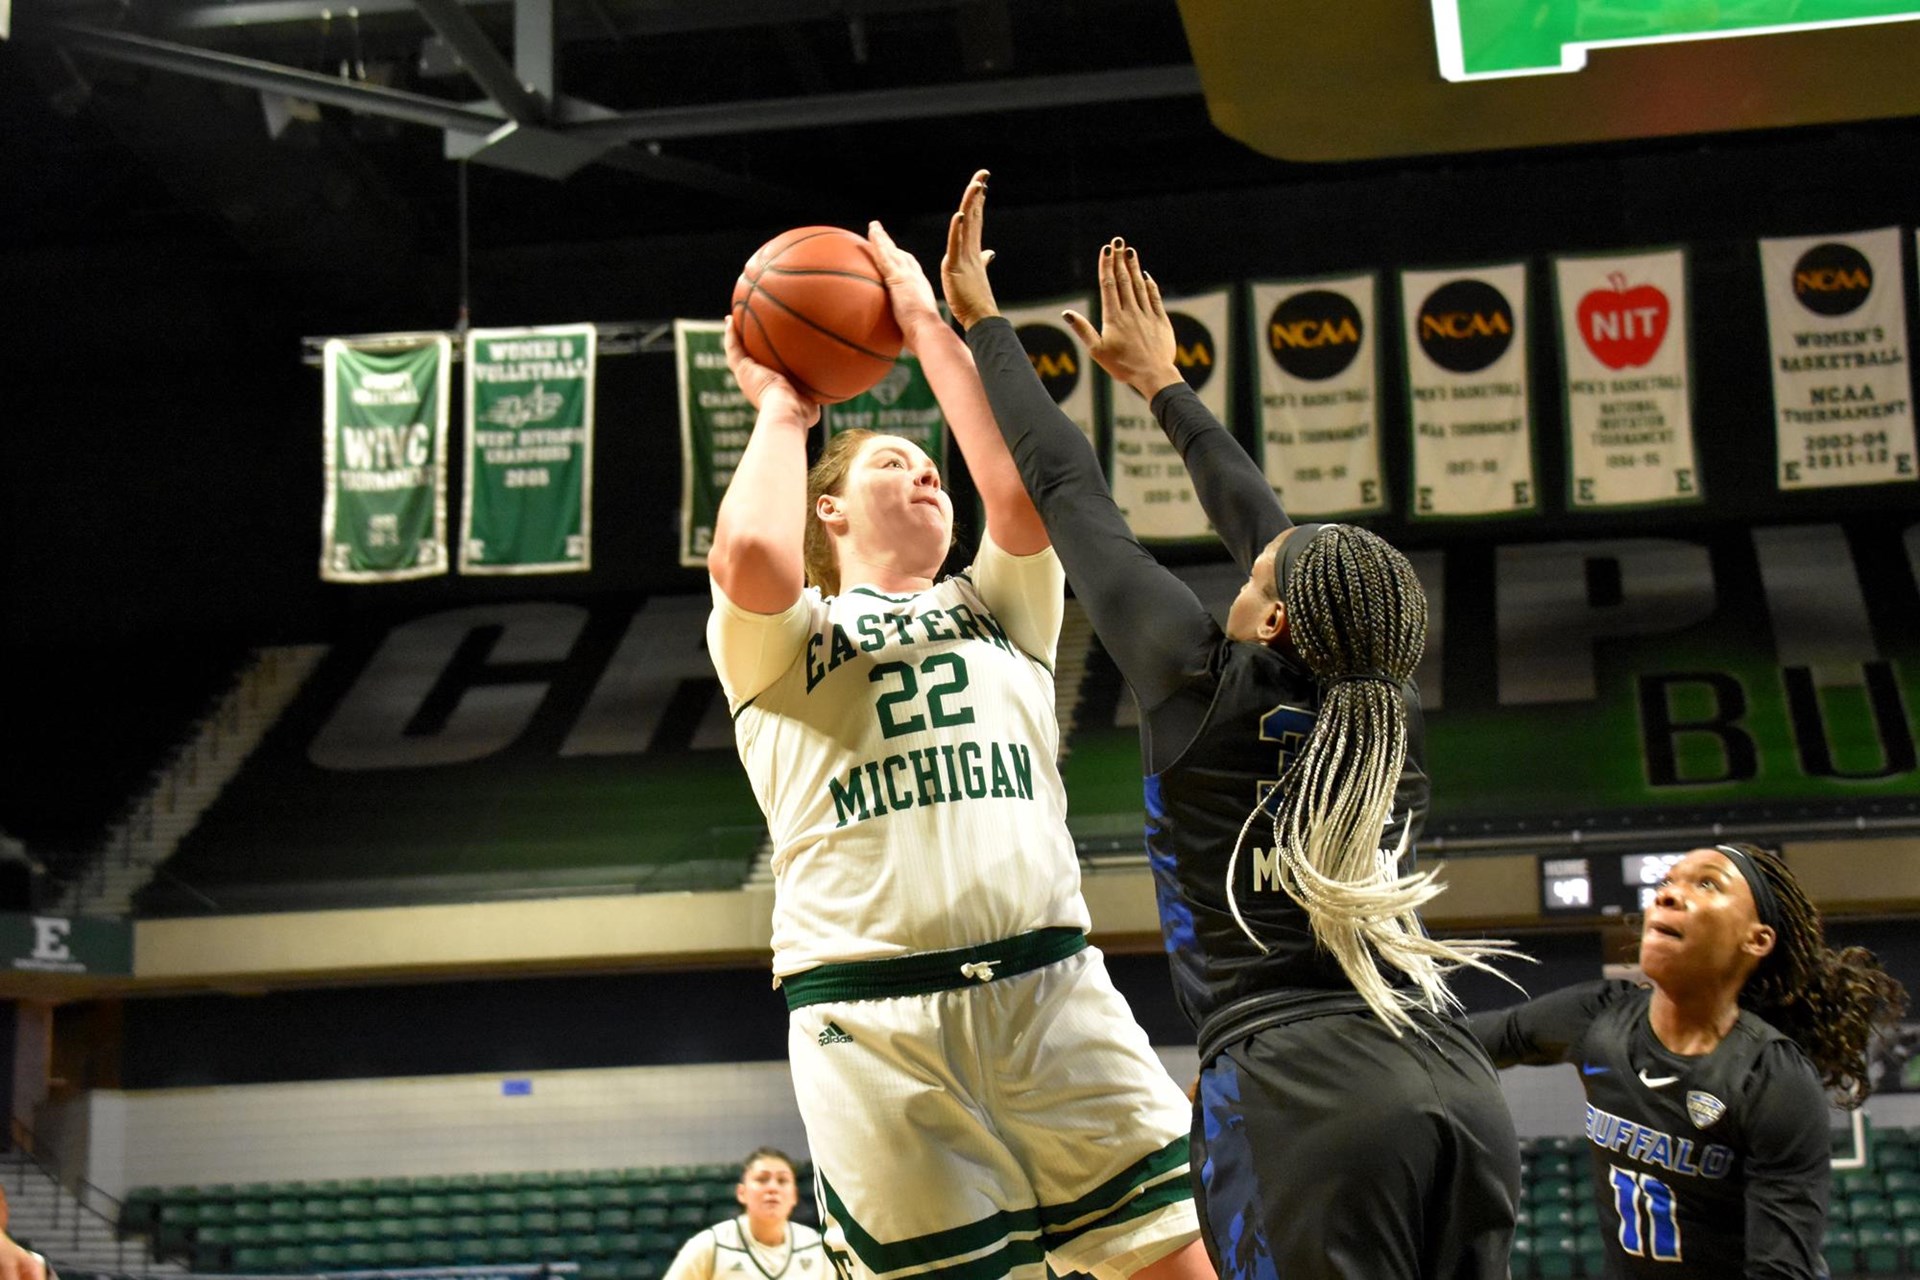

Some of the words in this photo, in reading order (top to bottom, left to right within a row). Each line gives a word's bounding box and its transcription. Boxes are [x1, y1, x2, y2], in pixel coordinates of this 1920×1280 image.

[1796, 266, 1869, 295] NCAA
[1271, 317, 1359, 349] NCAA
[1422, 311, 1510, 340] NCAA
[1591, 306, 1659, 342] NIT
[1794, 327, 1885, 347] WOMEN'S
[1779, 346, 1903, 371] BASKETBALL
[1811, 384, 1875, 405] NCAA
[1782, 400, 1906, 423] TOURNAMENT
[1784, 460, 1801, 481] E
[1896, 454, 1912, 474] E
[1359, 480, 1377, 503] E
[806, 604, 1016, 695] EASTERN
[868, 652, 976, 740] 22
[828, 741, 1034, 828] MICHIGAN
[31, 916, 71, 960] E
[818, 1035, 854, 1047] adidas
[1609, 1163, 1683, 1263] 11
